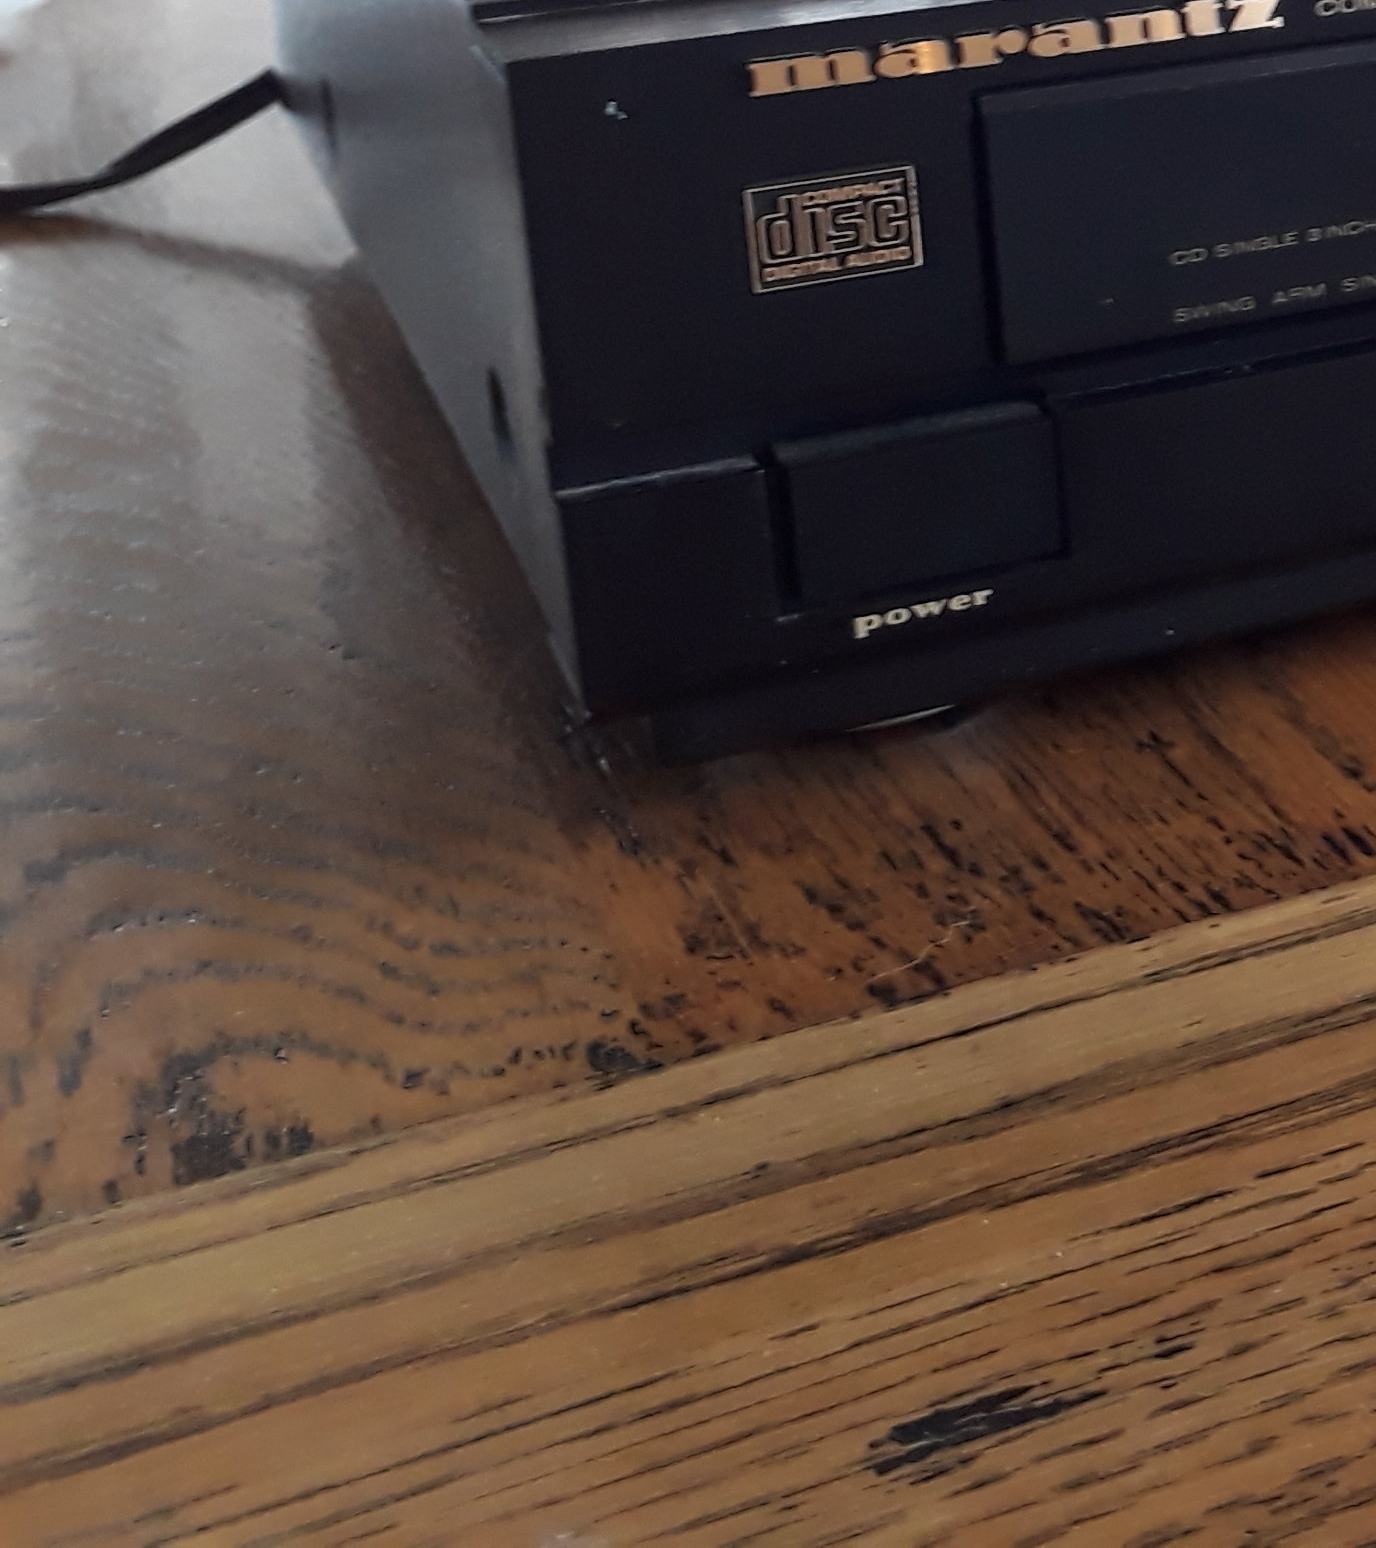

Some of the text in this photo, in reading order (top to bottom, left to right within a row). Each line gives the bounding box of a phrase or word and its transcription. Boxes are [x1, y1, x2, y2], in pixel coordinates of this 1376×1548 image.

[1167, 247, 1208, 266] CD
[1215, 231, 1299, 259] SINGLE
[1172, 295, 1257, 323] SWING
[1270, 282, 1328, 306] ARM
[852, 587, 996, 640] power
